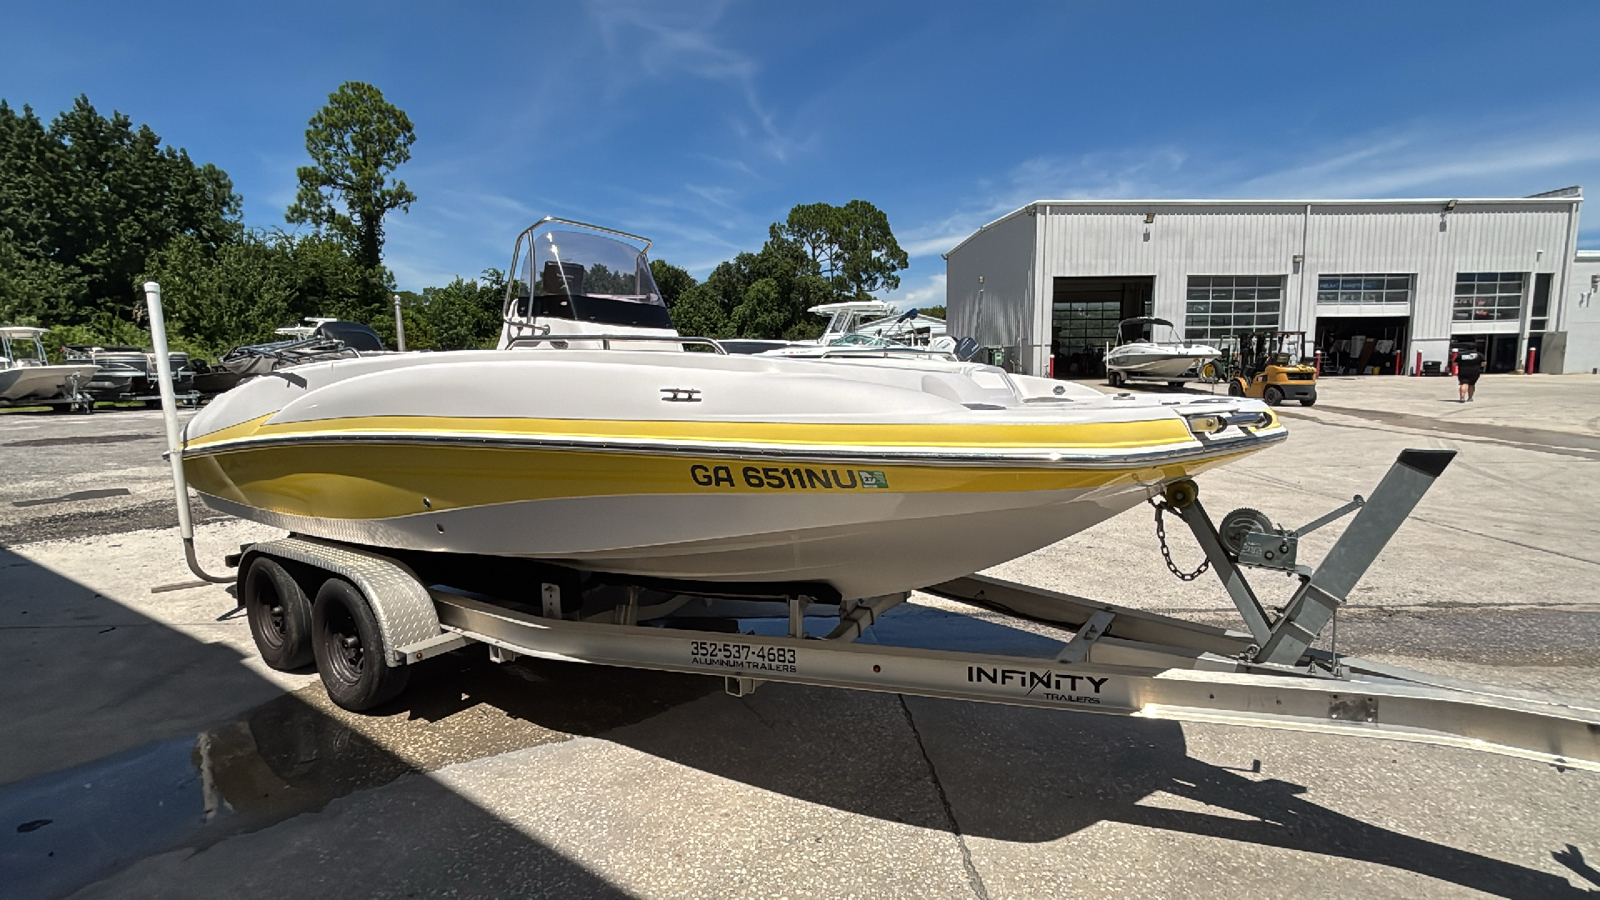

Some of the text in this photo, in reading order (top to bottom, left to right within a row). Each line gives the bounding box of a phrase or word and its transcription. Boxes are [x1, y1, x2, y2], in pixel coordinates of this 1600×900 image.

[691, 465, 857, 489] GA 6511NU
[691, 641, 796, 664] 352-537-4683
[691, 657, 797, 673] ALUMINUM TRAILERS
[968, 666, 1109, 696] INFINITY
[1043, 693, 1101, 704] TRAILERS
